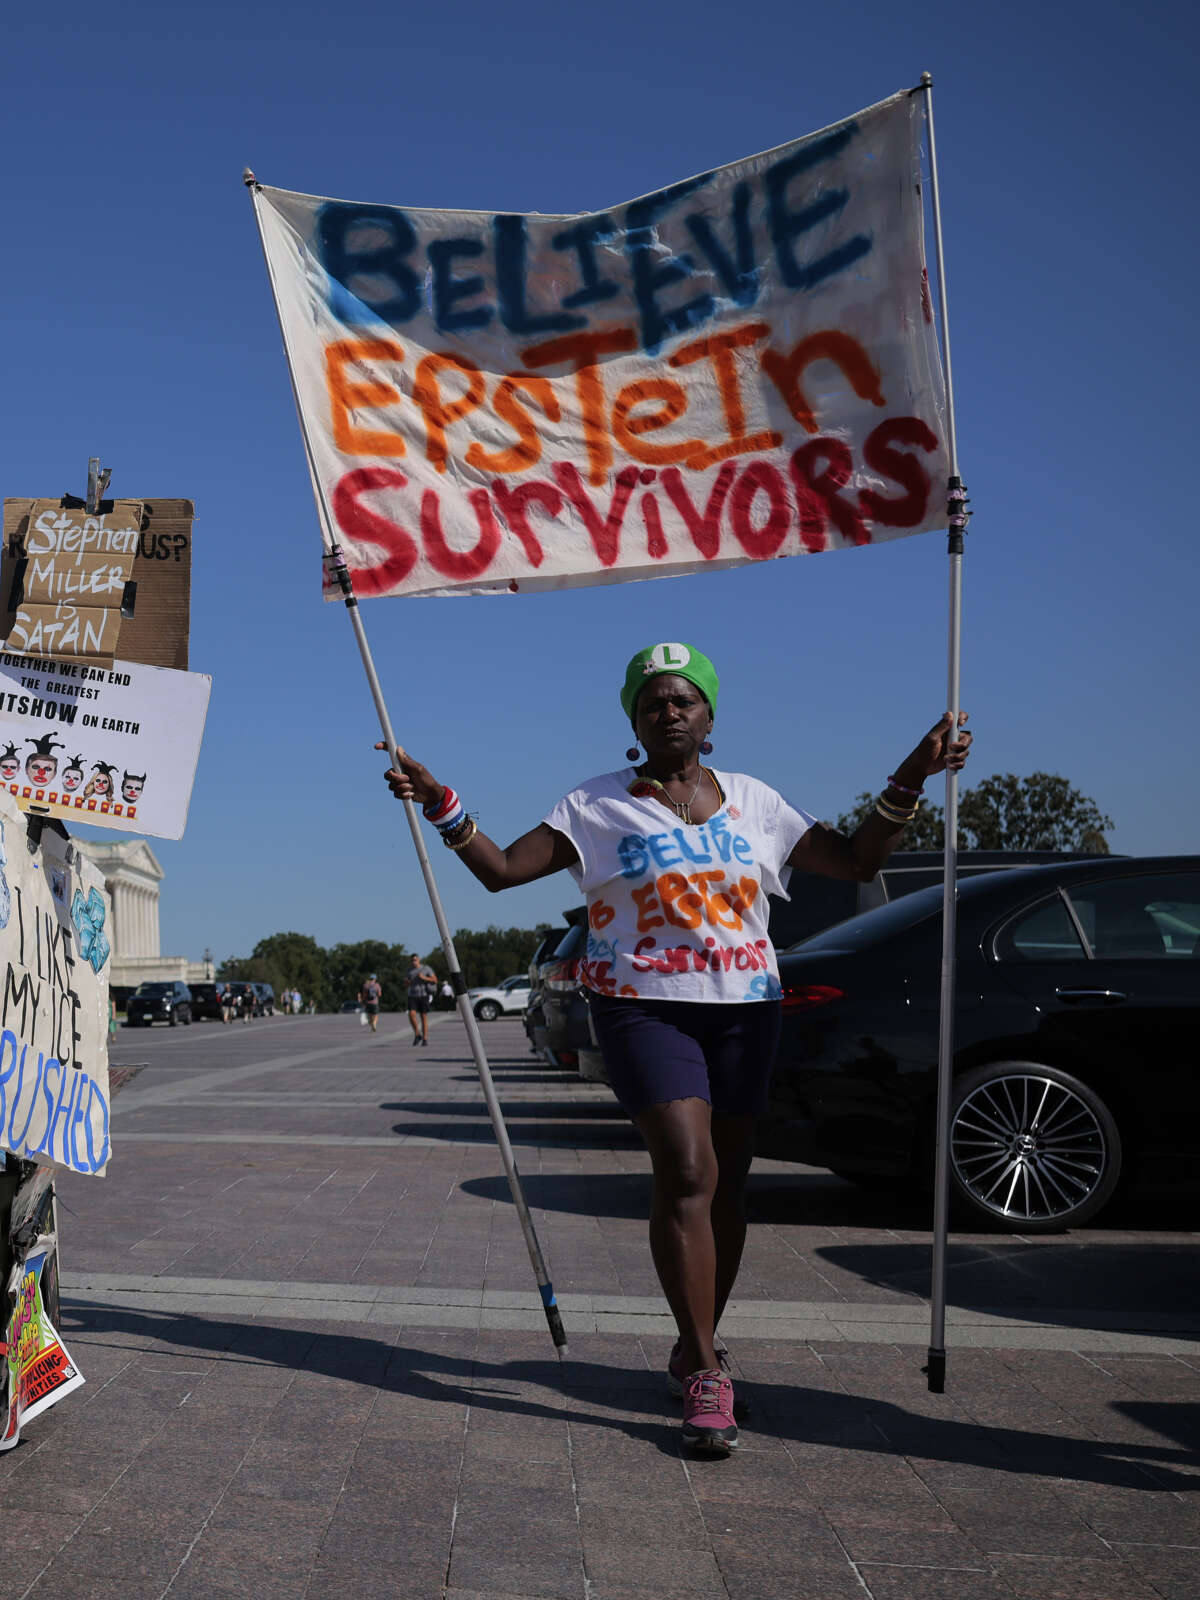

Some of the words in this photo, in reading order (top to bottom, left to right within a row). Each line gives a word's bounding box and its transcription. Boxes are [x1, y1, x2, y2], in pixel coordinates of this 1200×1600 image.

[27, 510, 139, 566] Stephen
[135, 533, 188, 561] US?
[55, 598, 77, 620] IS
[5, 604, 107, 657] SATAN
[663, 646, 681, 664] L
[60, 663, 77, 677] WE
[80, 667, 105, 682] CAN
[108, 672, 131, 686] END
[21, 677, 40, 690] THE
[46, 681, 100, 700] GREATEST
[82, 714, 98, 728] ON
[102, 717, 140, 735] EARTH
[14, 886, 26, 967] I
[36, 906, 78, 999] LIKE
[2, 962, 40, 1046] MY
[51, 988, 83, 1070] ICE
